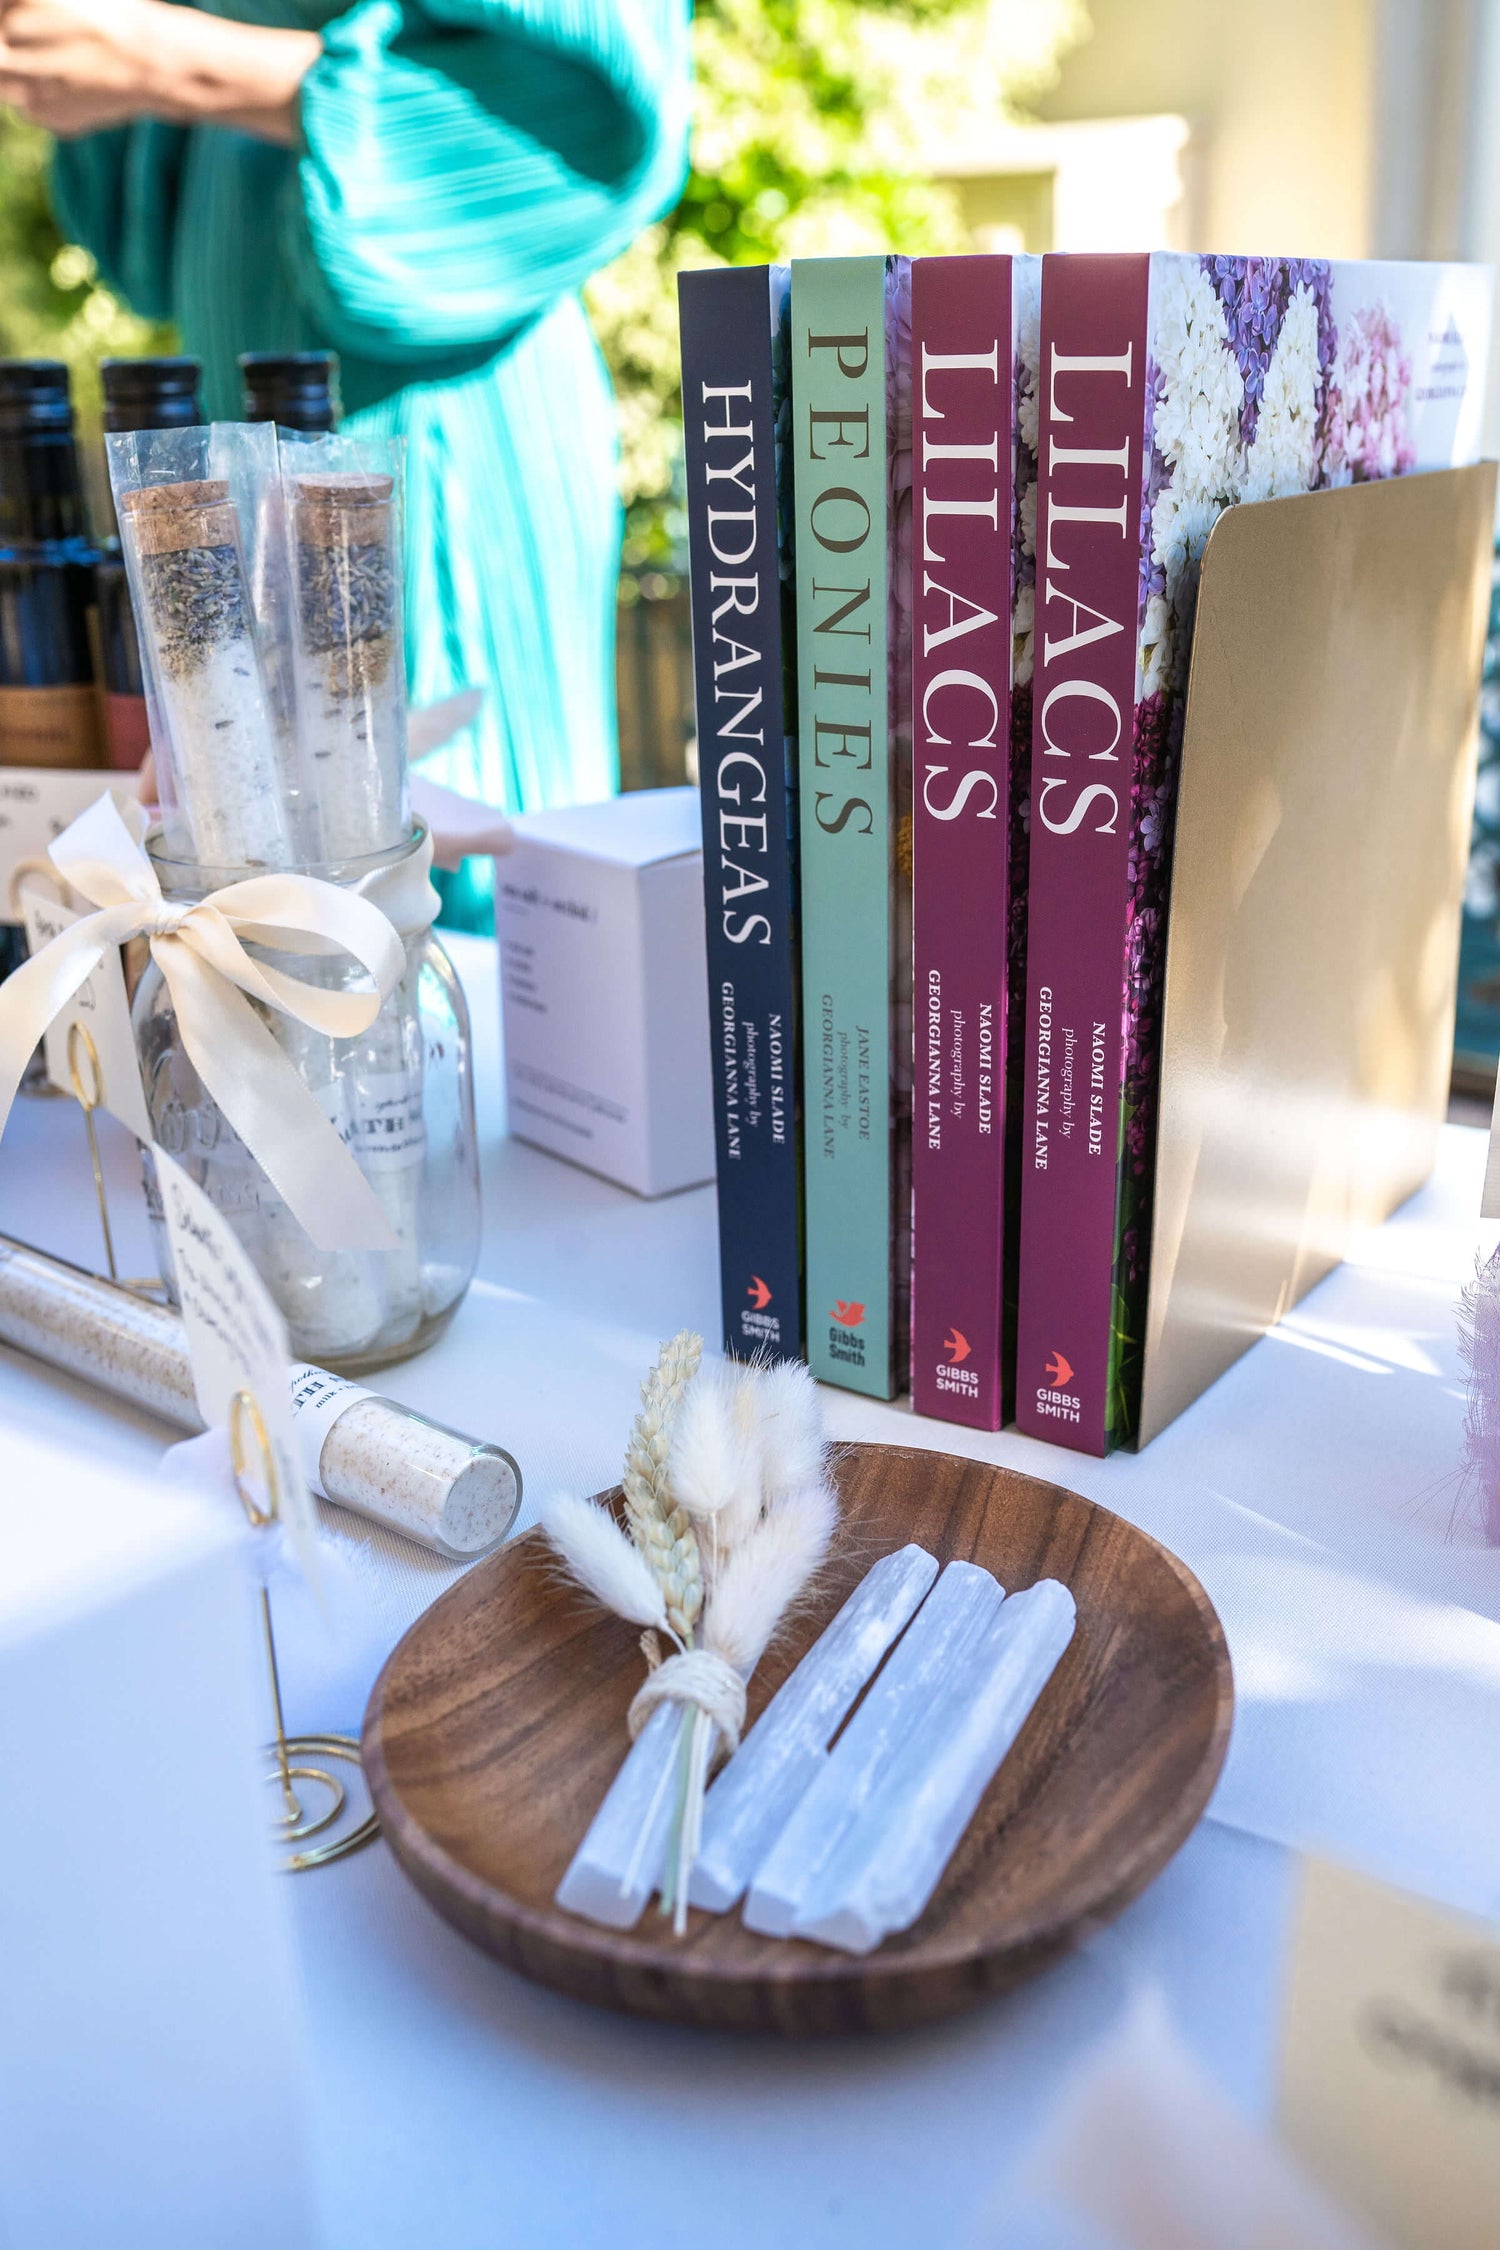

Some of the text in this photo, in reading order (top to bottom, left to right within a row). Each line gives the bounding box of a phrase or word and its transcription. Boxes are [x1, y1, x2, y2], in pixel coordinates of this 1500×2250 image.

[808, 326, 874, 836] PEONIES
[921, 338, 999, 822] LILACS
[1039, 341, 1133, 835] LILACS
[701, 379, 772, 946] HYDRANGEAS
[721, 981, 742, 1160] GEORGIANNA LANE
[742, 1020, 762, 1127] photography by
[768, 1012, 786, 1145] NAOMI SLADE
[821, 994, 836, 1160] GEORGIANNA LANE
[836, 1031, 852, 1130] photography by
[855, 1025, 871, 1141] JANE EASTOE
[928, 969, 941, 1150] GEORGIANNA LANE
[950, 1009, 966, 1120] photography by
[978, 1002, 992, 1135] NAOMI SLADE
[1035, 986, 1052, 1170] GEORGIANNA LANE
[1059, 1027, 1078, 1139] photography by
[1088, 1021, 1106, 1155] NAOMI SLADE
[741, 1310, 780, 1330] GIBBS
[742, 1323, 780, 1342] SMITH
[829, 1327, 865, 1350] Gibbs
[829, 1343, 865, 1366] Smith
[936, 1364, 979, 1384] GIBBS
[315, 1390, 337, 1409] milk
[936, 1378, 978, 1398] SMITH
[1036, 1388, 1080, 1409] GIBBS
[1036, 1401, 1080, 1423] SMITH
